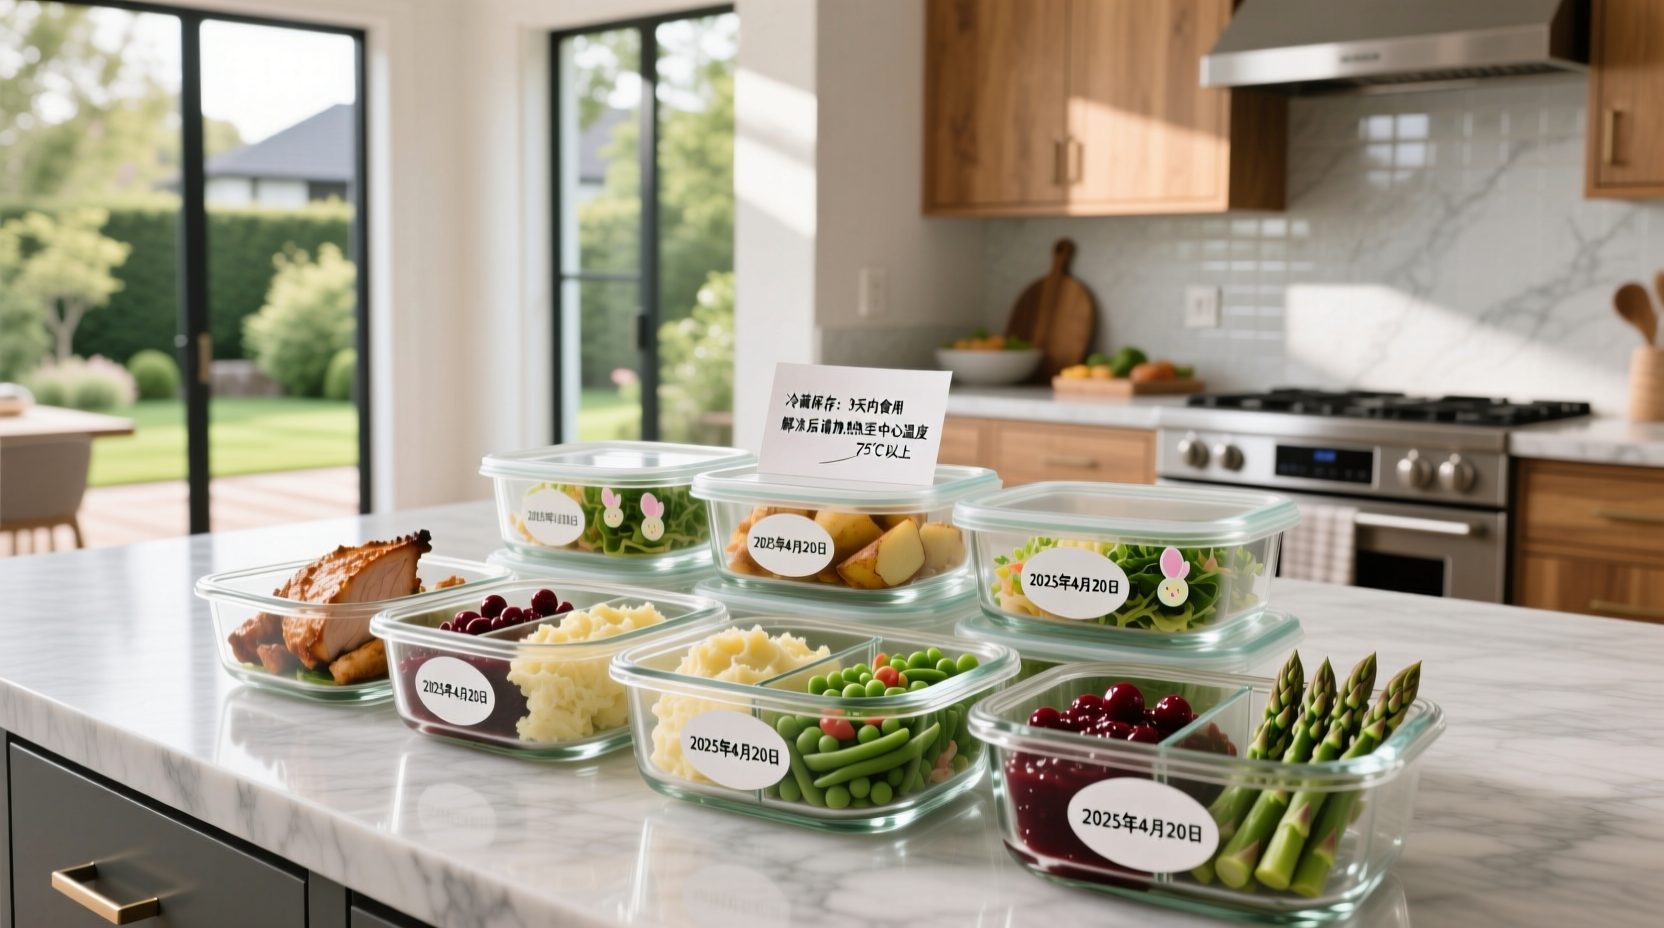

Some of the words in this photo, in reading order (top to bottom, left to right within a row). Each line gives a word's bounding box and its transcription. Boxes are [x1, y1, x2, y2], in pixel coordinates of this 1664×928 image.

[1029, 573, 1119, 594] 2025年4月20日
[690, 736, 779, 766] 2025年4月20日
[1082, 808, 1202, 844] 2025年4月20日
